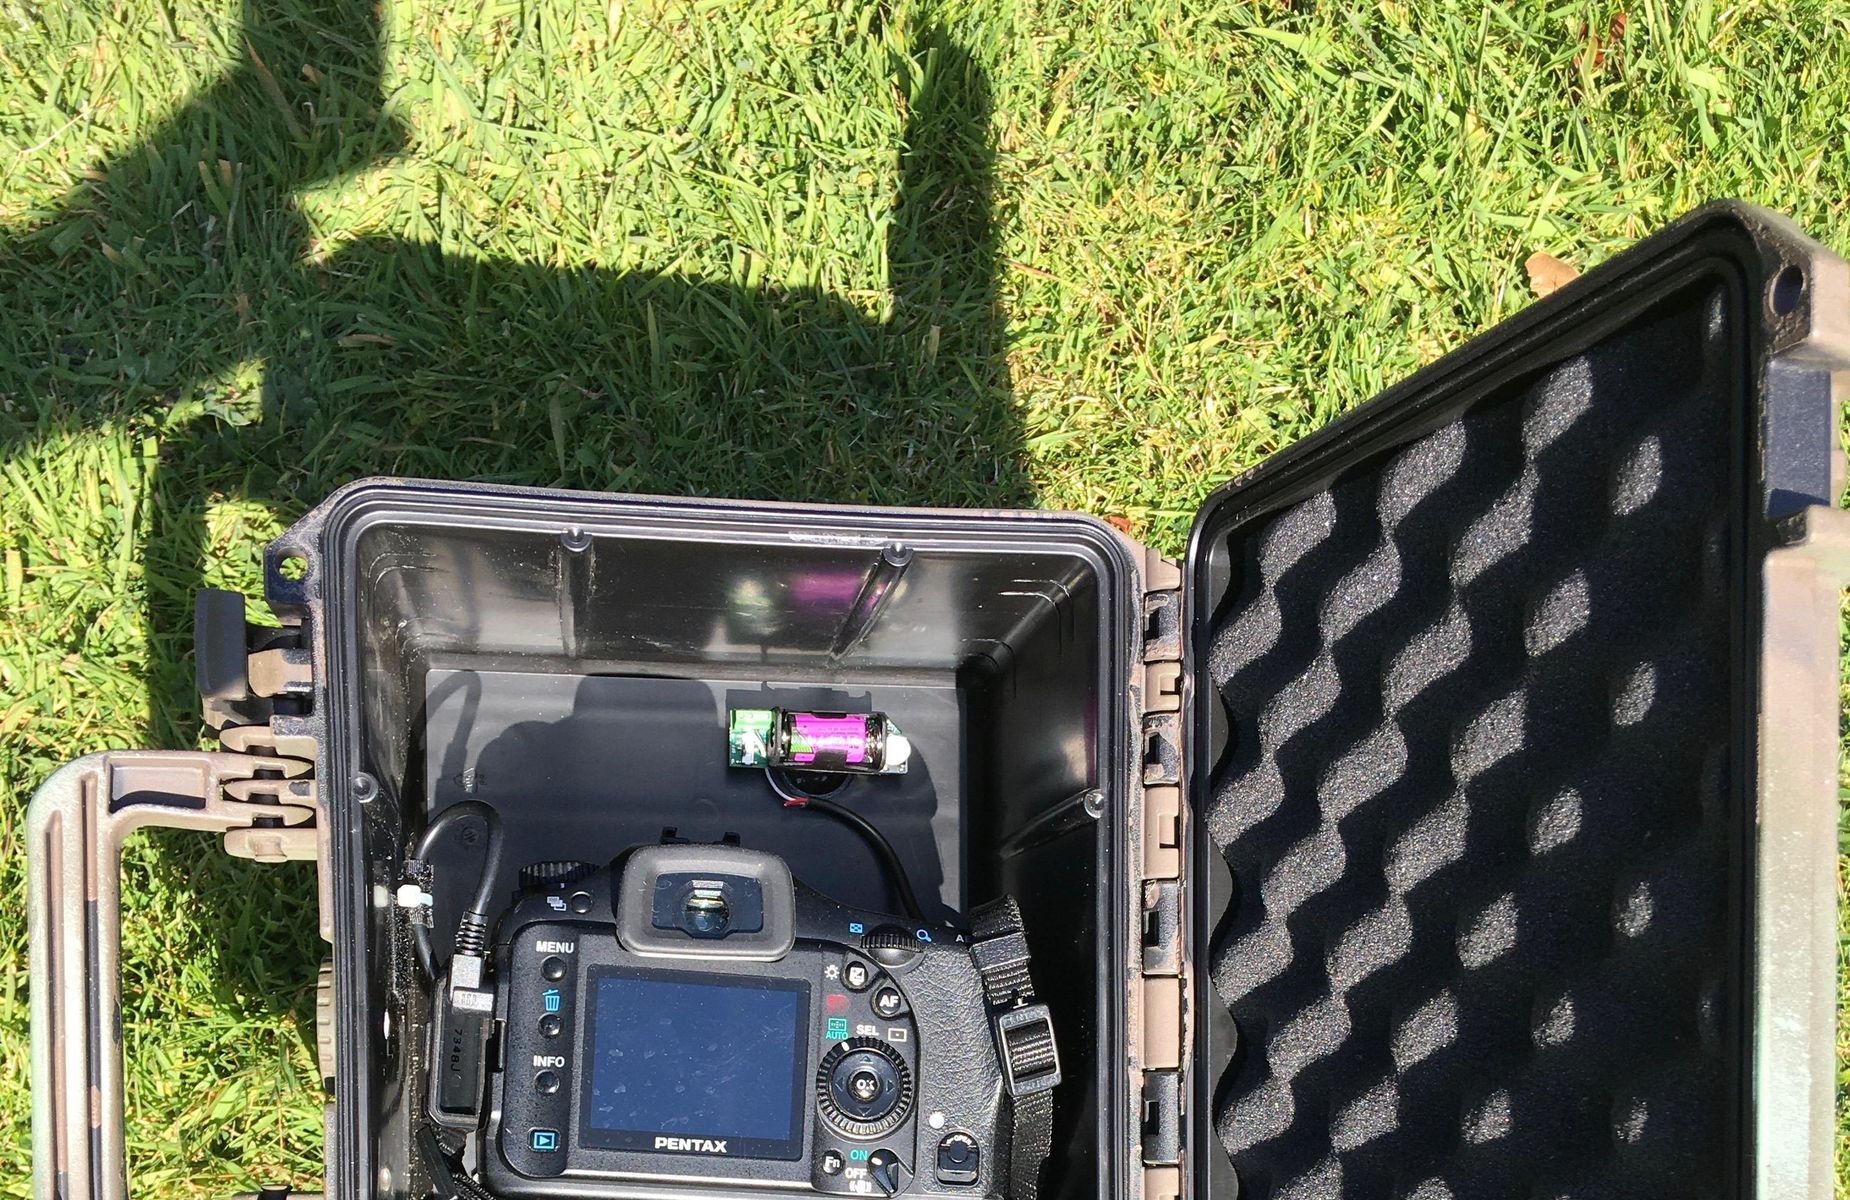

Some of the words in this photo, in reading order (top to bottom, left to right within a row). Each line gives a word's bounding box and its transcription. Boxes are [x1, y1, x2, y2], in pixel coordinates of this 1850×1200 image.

[536, 940, 575, 953] MENU
[880, 994, 899, 1008] AF
[826, 1030, 849, 1040] AUTO
[856, 1024, 880, 1036] SEL
[533, 1055, 565, 1068] INFO
[856, 1079, 875, 1090] OK
[654, 1136, 728, 1153] PENTAX
[850, 1149, 868, 1160] ON
[824, 1156, 841, 1168] Fn
[844, 1167, 868, 1179] OFF
